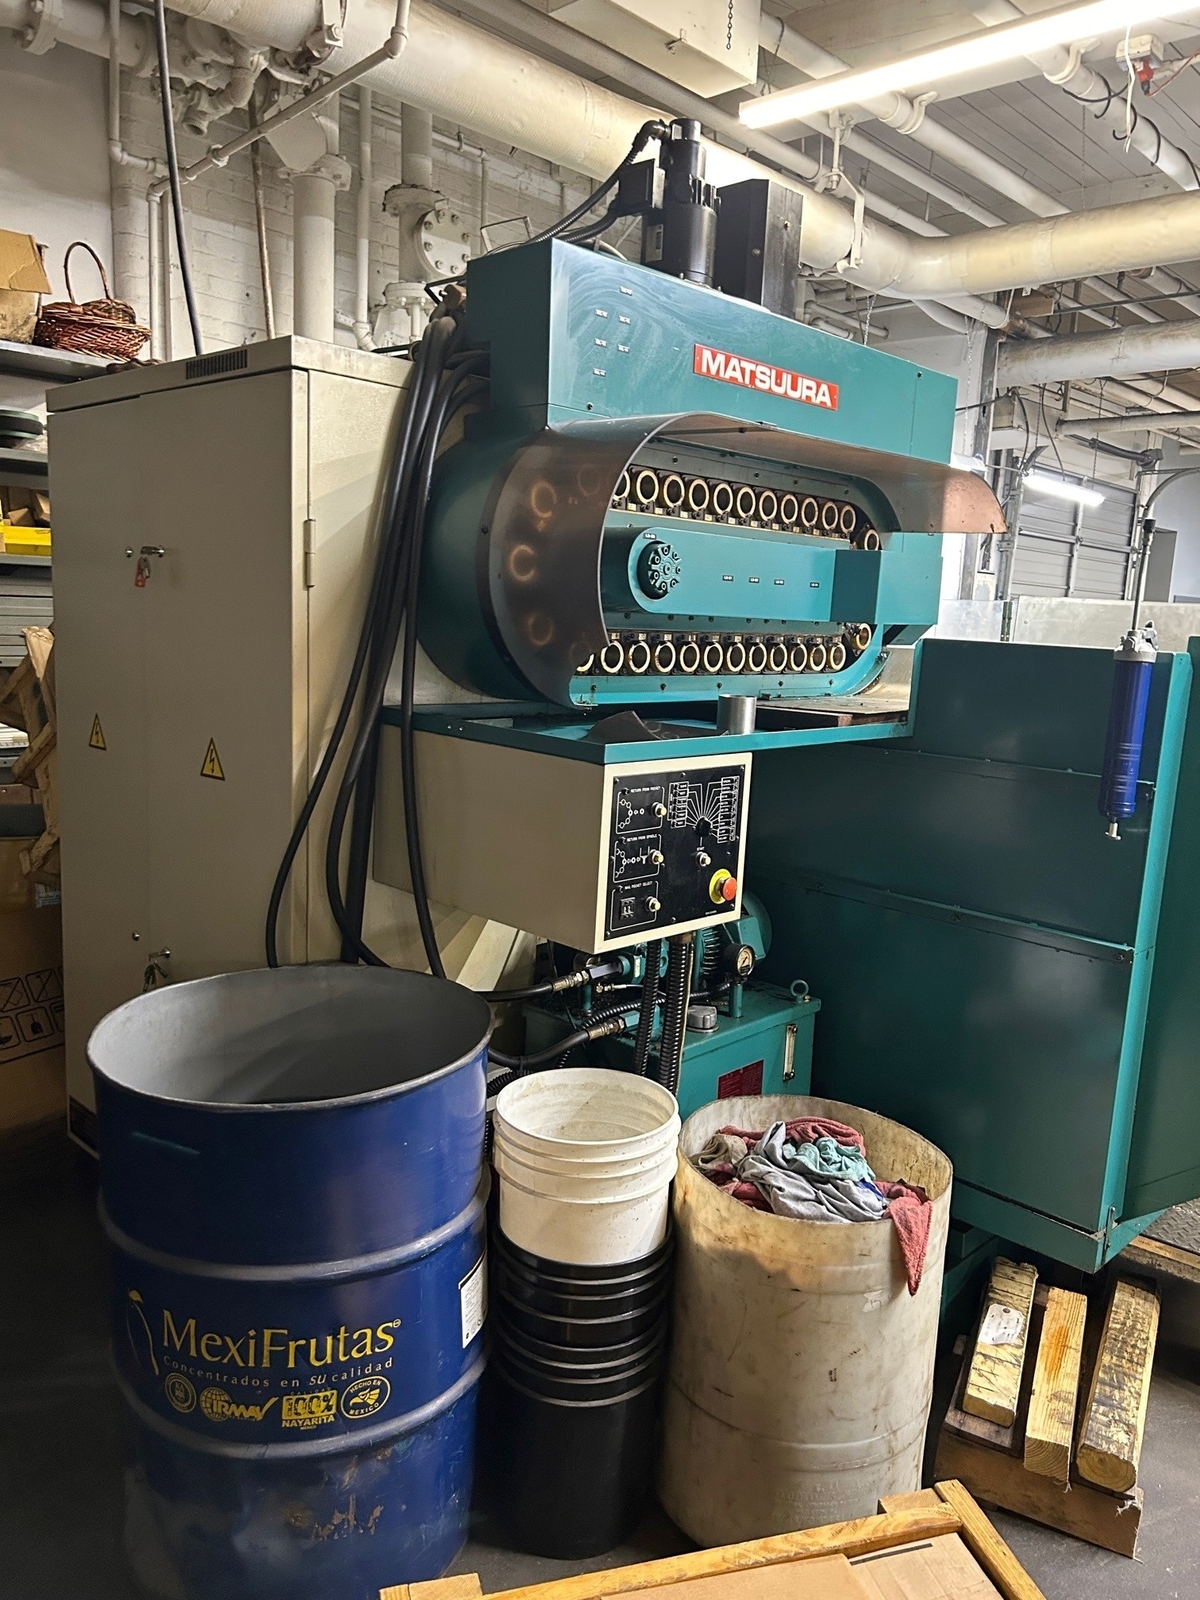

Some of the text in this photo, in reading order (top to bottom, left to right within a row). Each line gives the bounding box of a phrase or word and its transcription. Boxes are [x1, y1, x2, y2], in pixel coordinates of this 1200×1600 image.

[701, 349, 832, 407] MATSUURA
[163, 1355, 270, 1388] Concentrados
[280, 1379, 300, 1388] en
[331, 1356, 393, 1382] calidad
[349, 1379, 382, 1394] HECHO EN
[348, 1402, 380, 1416] MEXICO
[281, 1414, 336, 1428] NAYARITA
